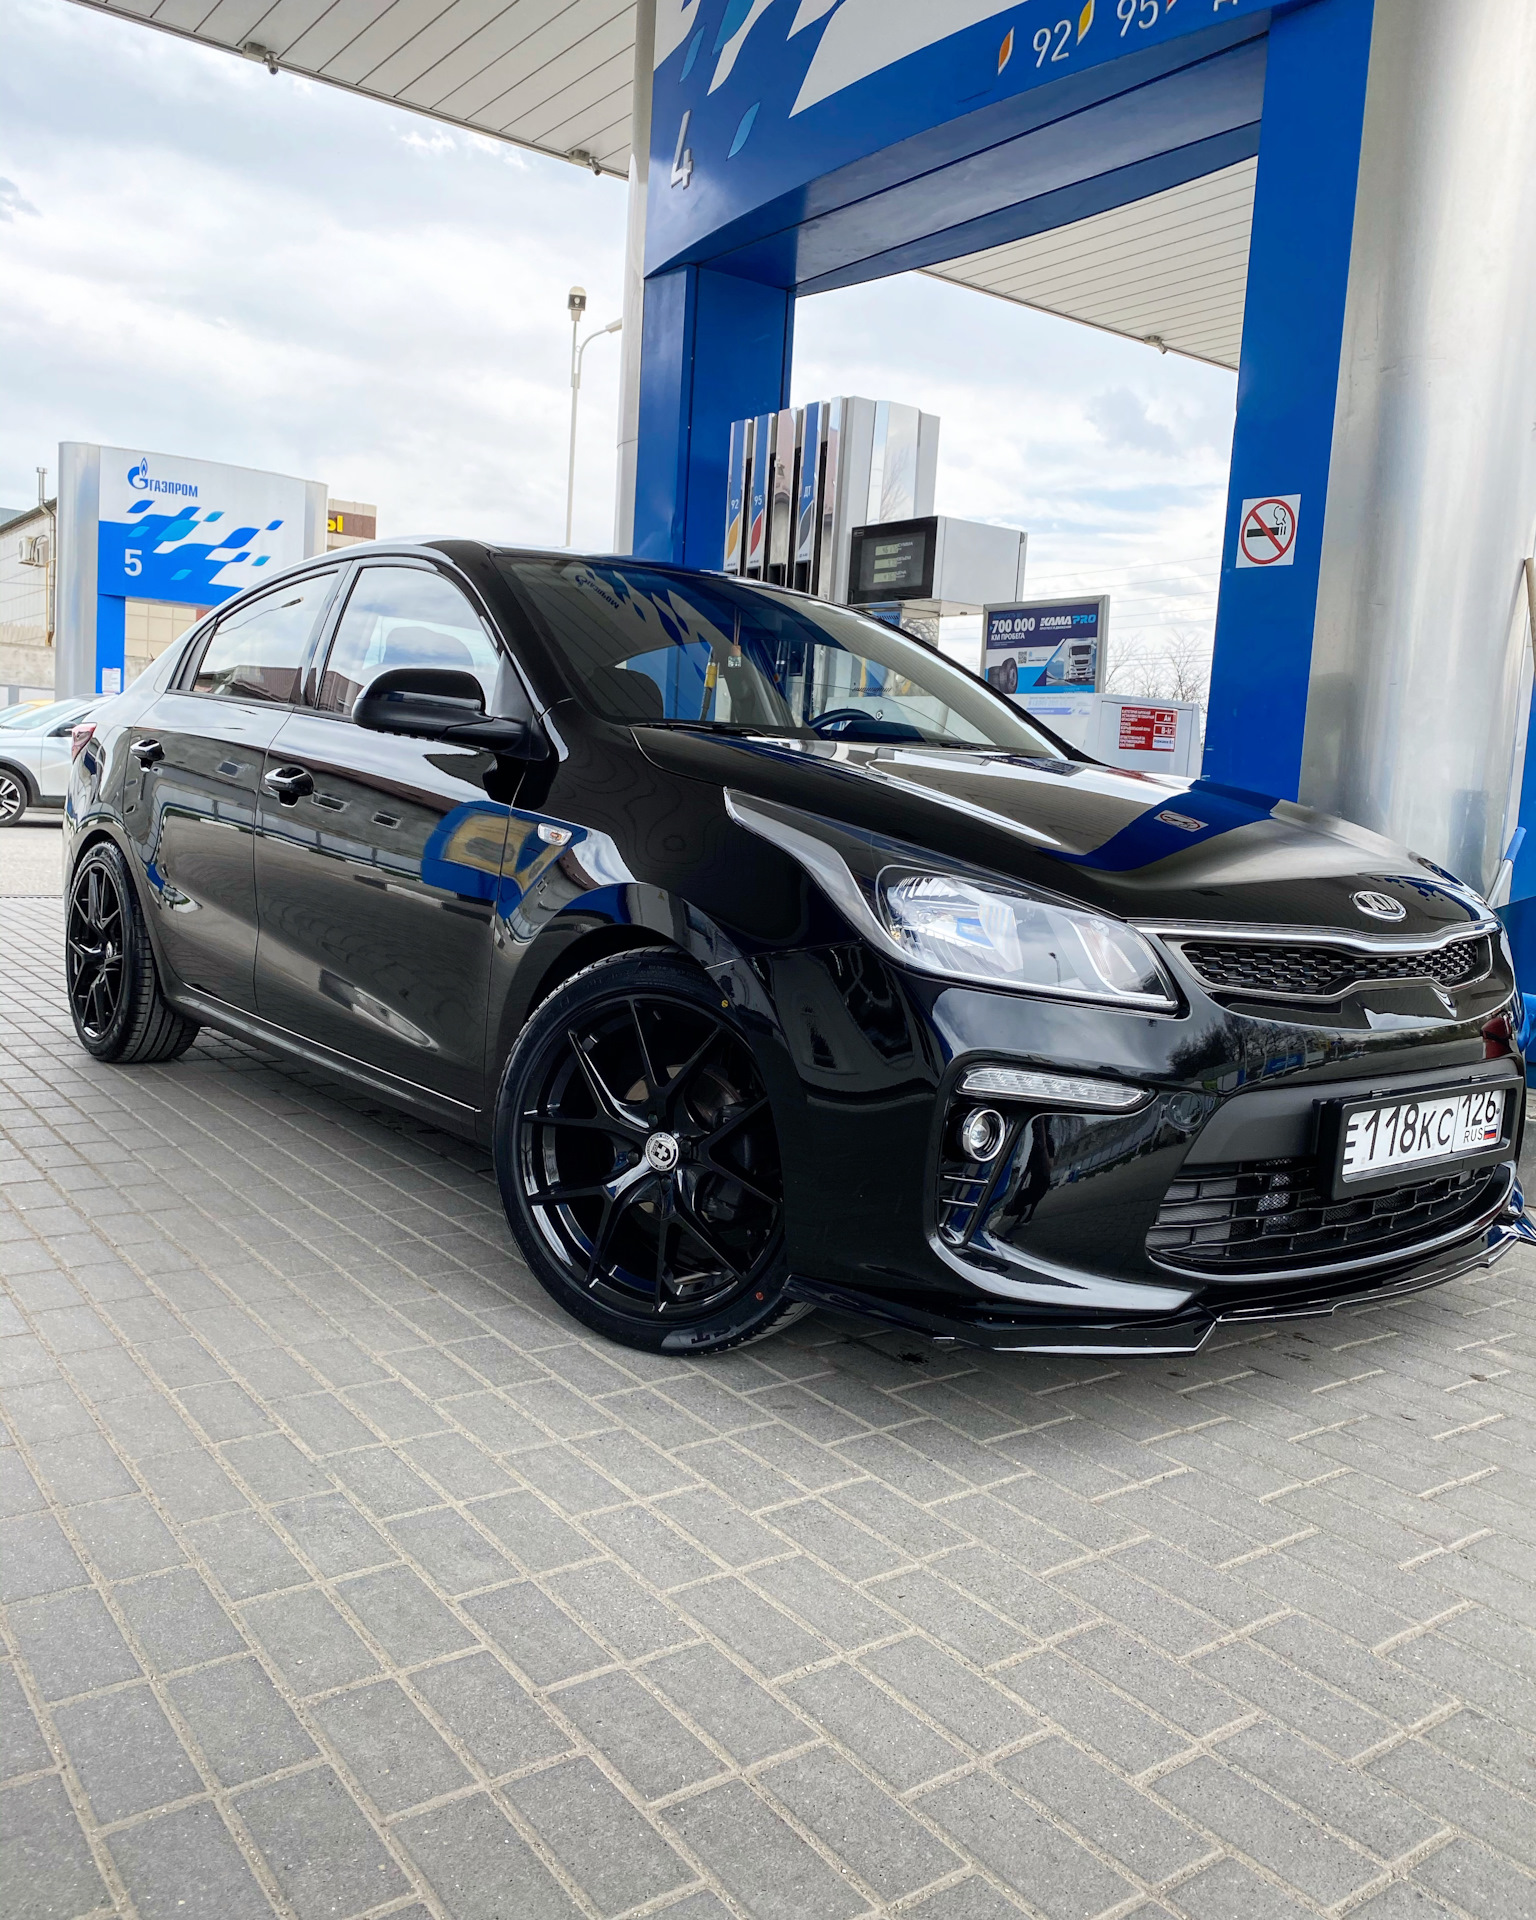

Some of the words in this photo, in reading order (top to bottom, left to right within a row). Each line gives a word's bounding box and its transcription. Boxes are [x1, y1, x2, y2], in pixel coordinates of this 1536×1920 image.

[1033, 19, 1072, 69] 92
[1116, 0, 1159, 38] 95
[671, 109, 693, 190] 4
[149, 479, 198, 498] ГАЗПРОМ
[803, 485, 812, 498] ДТ
[730, 498, 739, 510] 92
[753, 494, 763, 506] 95
[124, 549, 143, 577] 5
[992, 619, 1012, 634] 700
[1014, 617, 1035, 632] 000
[991, 633, 1001, 641] КМ
[1001, 632, 1025, 640] ПРОБЕГА
[1462, 1091, 1498, 1128] 126
[1463, 1127, 1484, 1144] RUS
